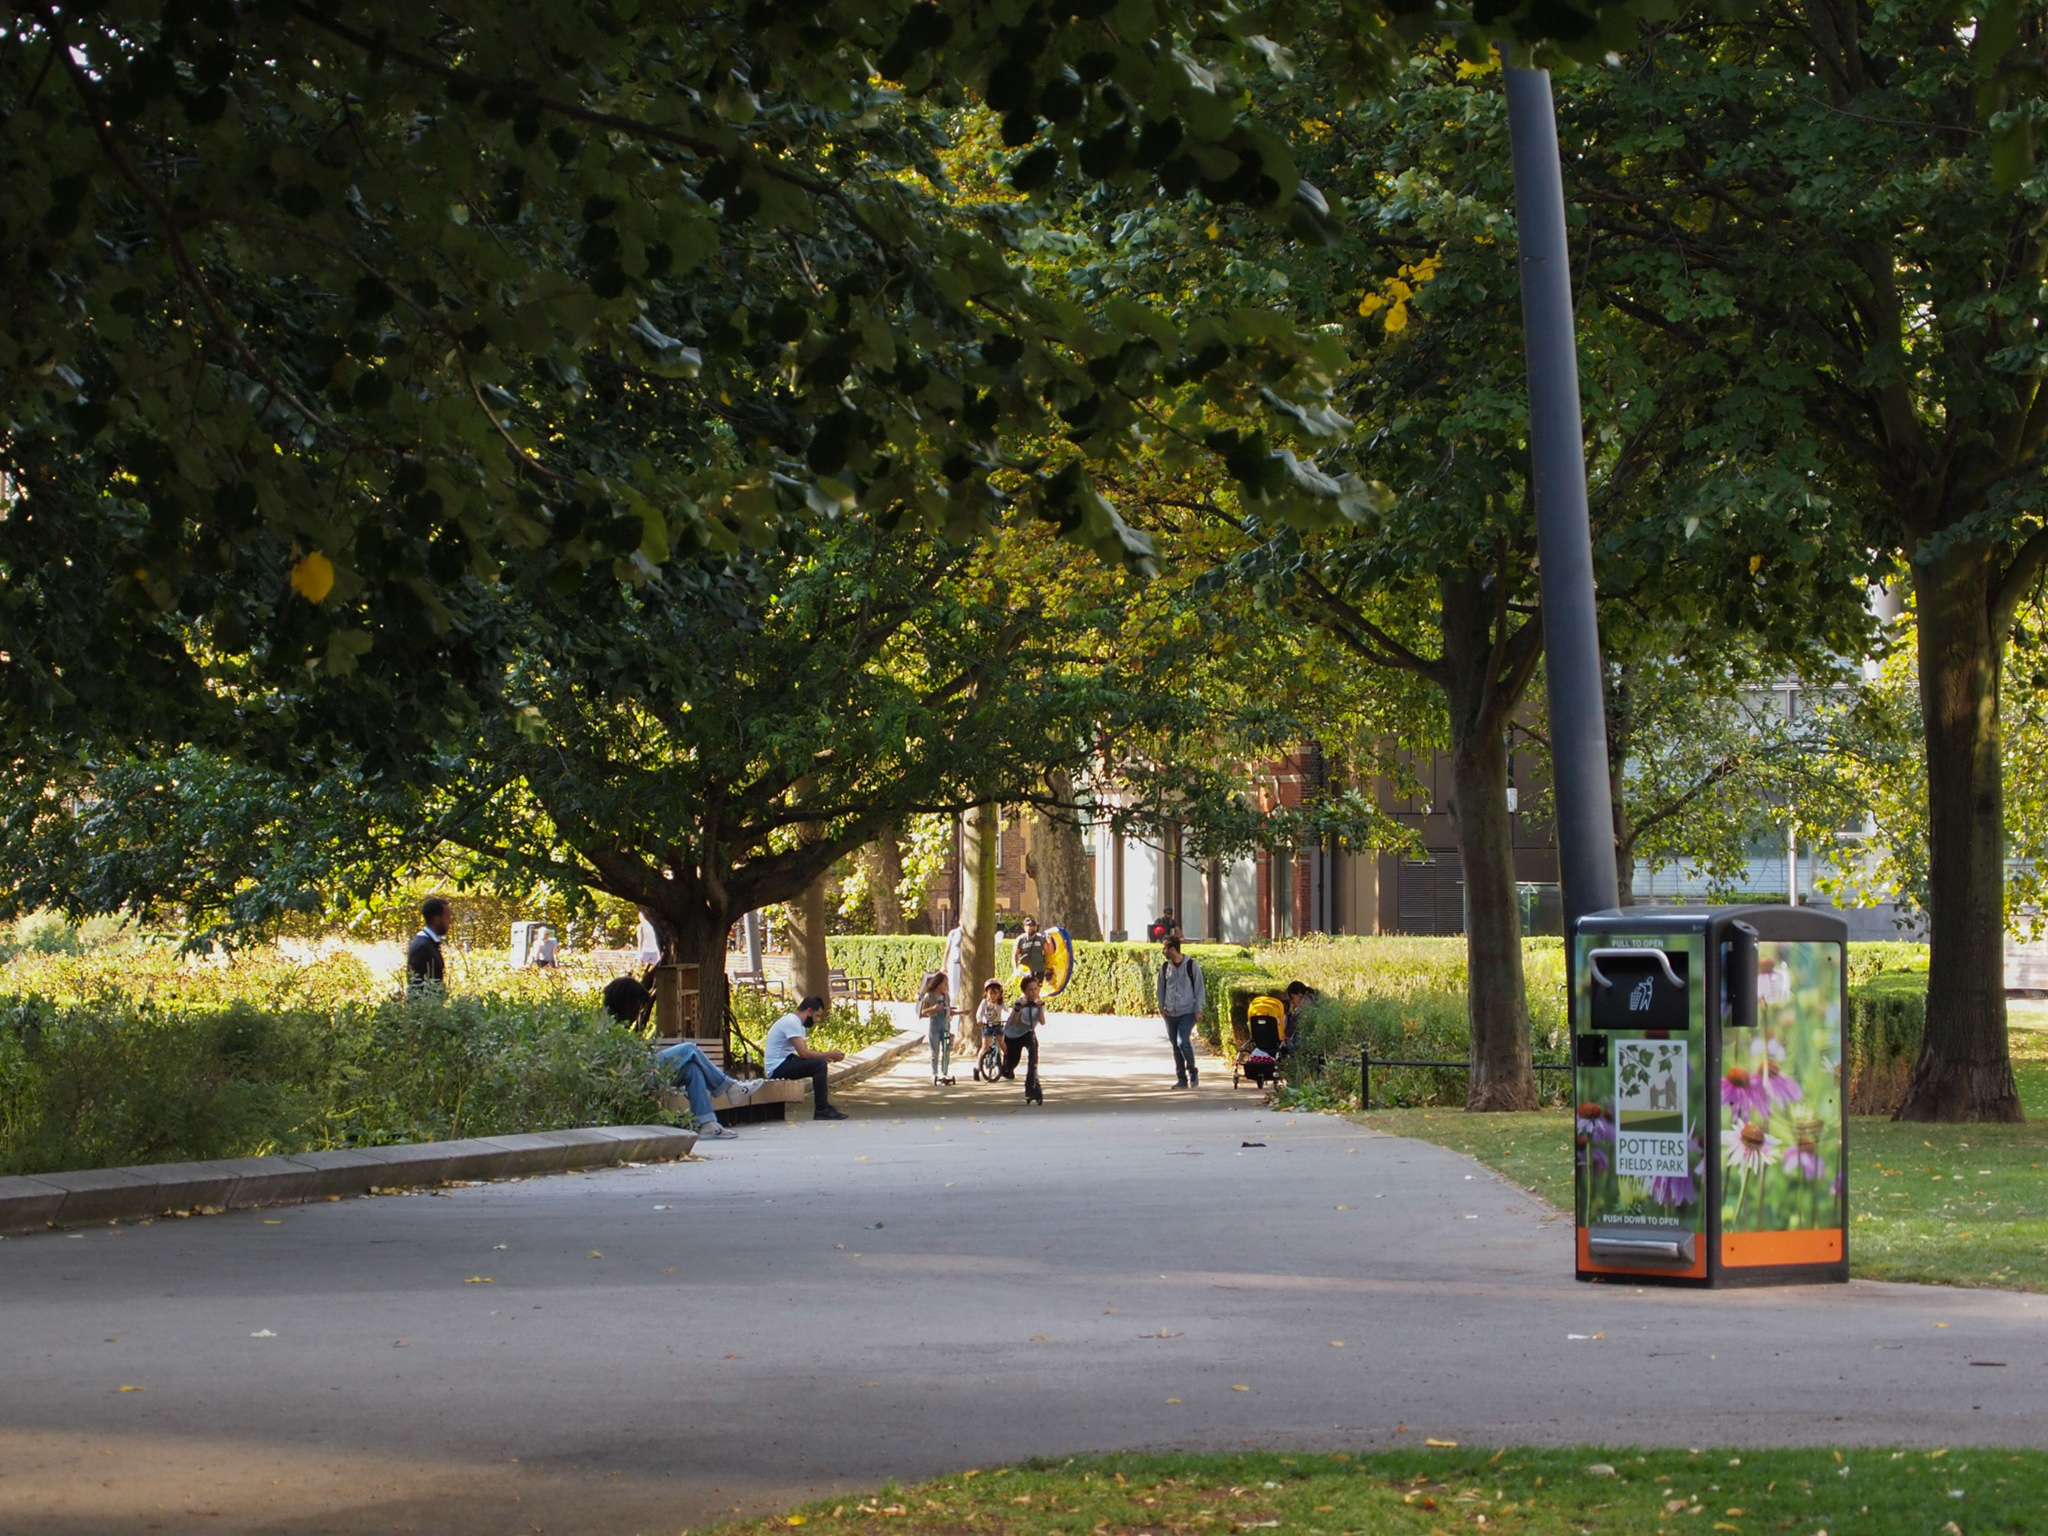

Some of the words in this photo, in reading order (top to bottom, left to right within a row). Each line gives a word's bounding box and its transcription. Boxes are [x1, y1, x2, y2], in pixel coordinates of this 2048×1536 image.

[1611, 939, 1630, 948] PULL
[1632, 939, 1642, 948] TO
[1643, 939, 1664, 948] OPEN
[1619, 1138, 1685, 1157] POTTERS
[1619, 1157, 1653, 1172] FIELDS
[1656, 1158, 1685, 1173] PARK
[1602, 1214, 1623, 1224] PUSH
[1624, 1215, 1646, 1225] DOWN
[1648, 1216, 1658, 1226] TO
[1659, 1217, 1680, 1227] OPEN
